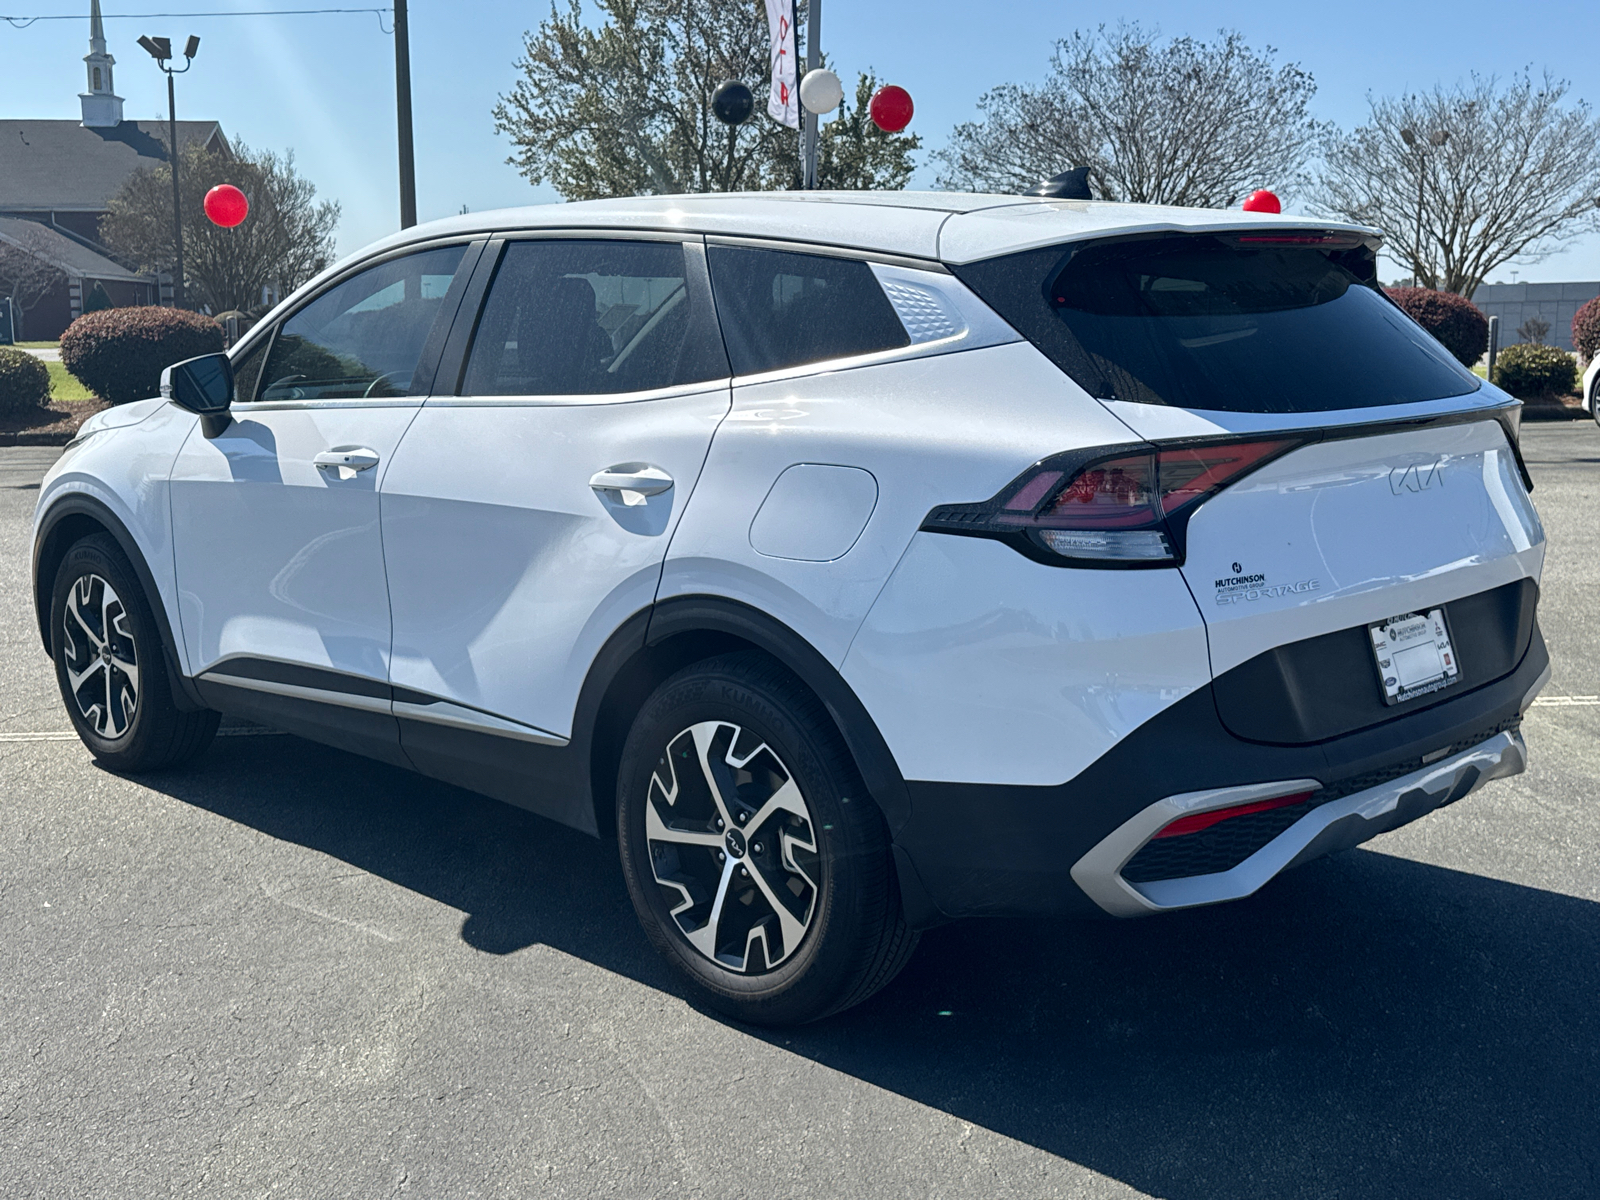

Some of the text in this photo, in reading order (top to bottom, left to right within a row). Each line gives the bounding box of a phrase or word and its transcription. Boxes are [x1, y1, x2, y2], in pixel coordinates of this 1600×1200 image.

[1388, 459, 1444, 496] KIA
[1215, 573, 1265, 588] HUTCHINSON
[1215, 578, 1321, 606] SPORTAGE
[1217, 584, 1248, 593] AUTOMOTIVE
[721, 685, 785, 732] KUMHO
